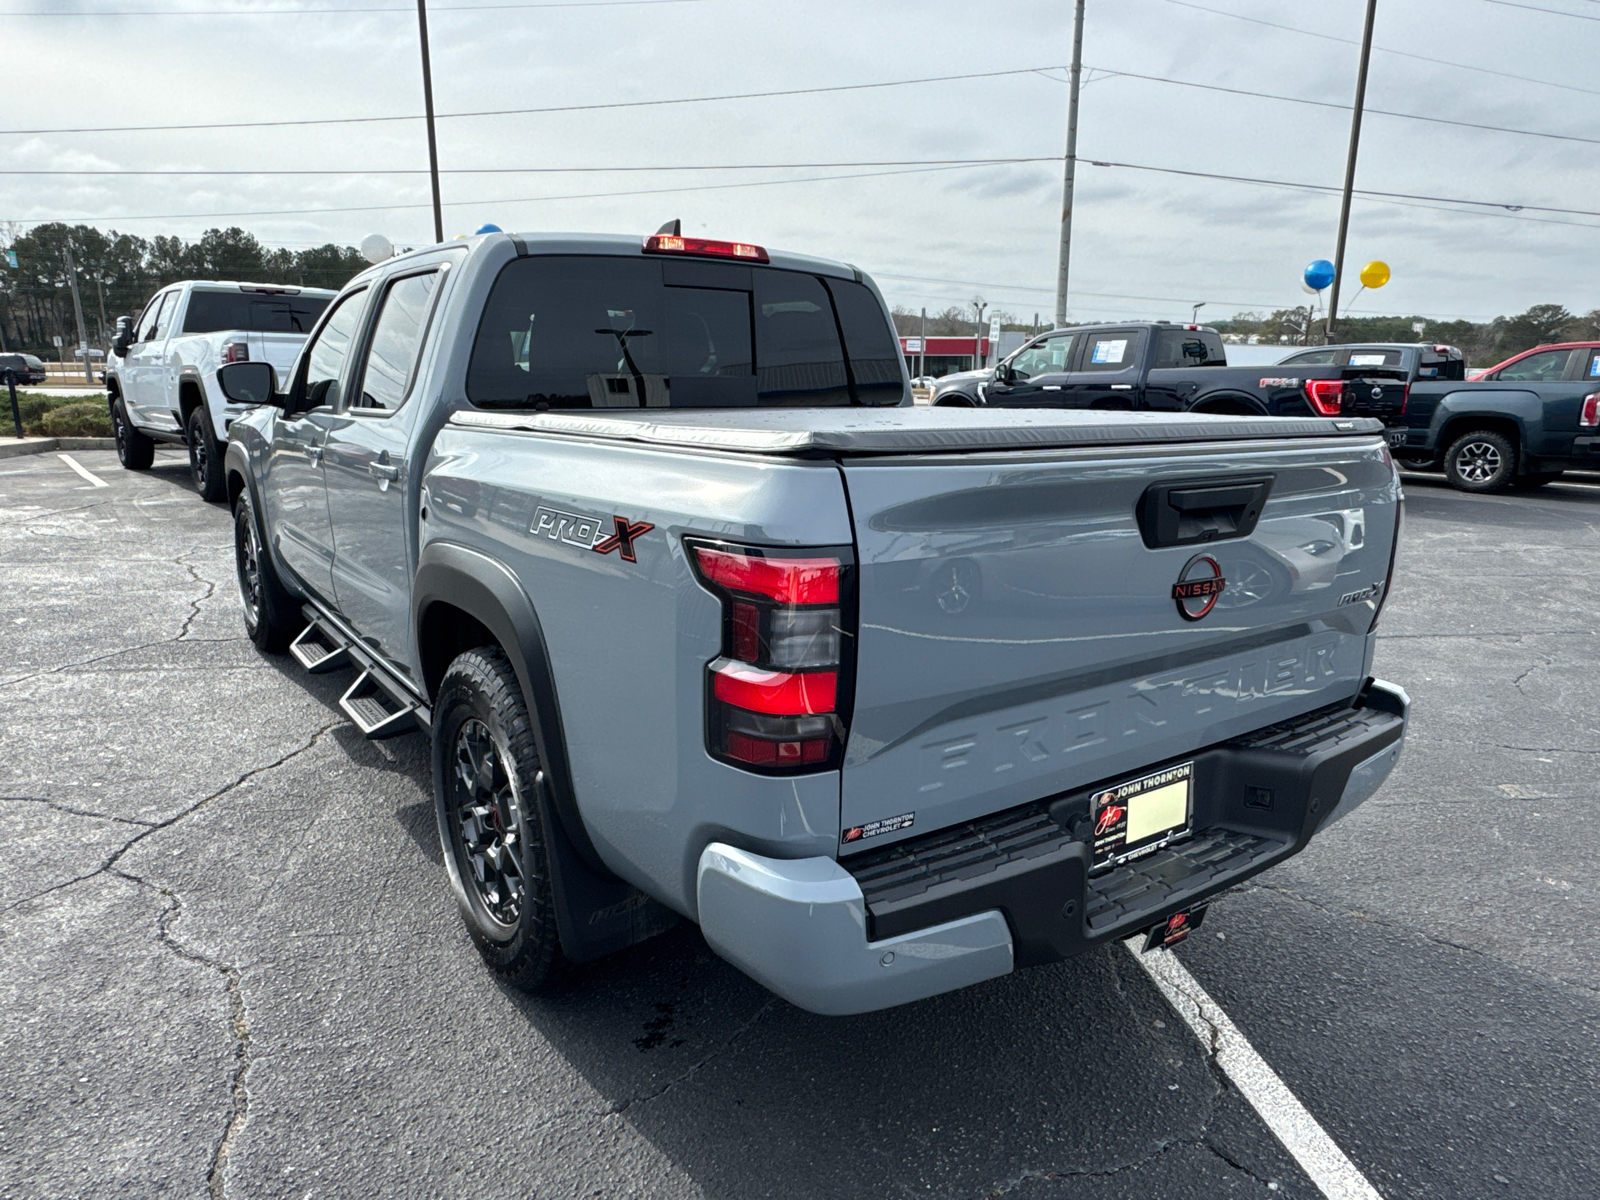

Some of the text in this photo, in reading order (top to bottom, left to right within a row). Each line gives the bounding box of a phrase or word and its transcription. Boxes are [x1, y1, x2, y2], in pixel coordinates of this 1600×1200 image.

[1259, 377, 1299, 389] FX4
[1175, 580, 1225, 597] NISSAN
[1117, 765, 1190, 798] JOHN THORNTON
[862, 823, 901, 838] CHEVROLET
[863, 813, 914, 832] JOHN THORNTON
[1128, 844, 1158, 860] CHEVROLET
